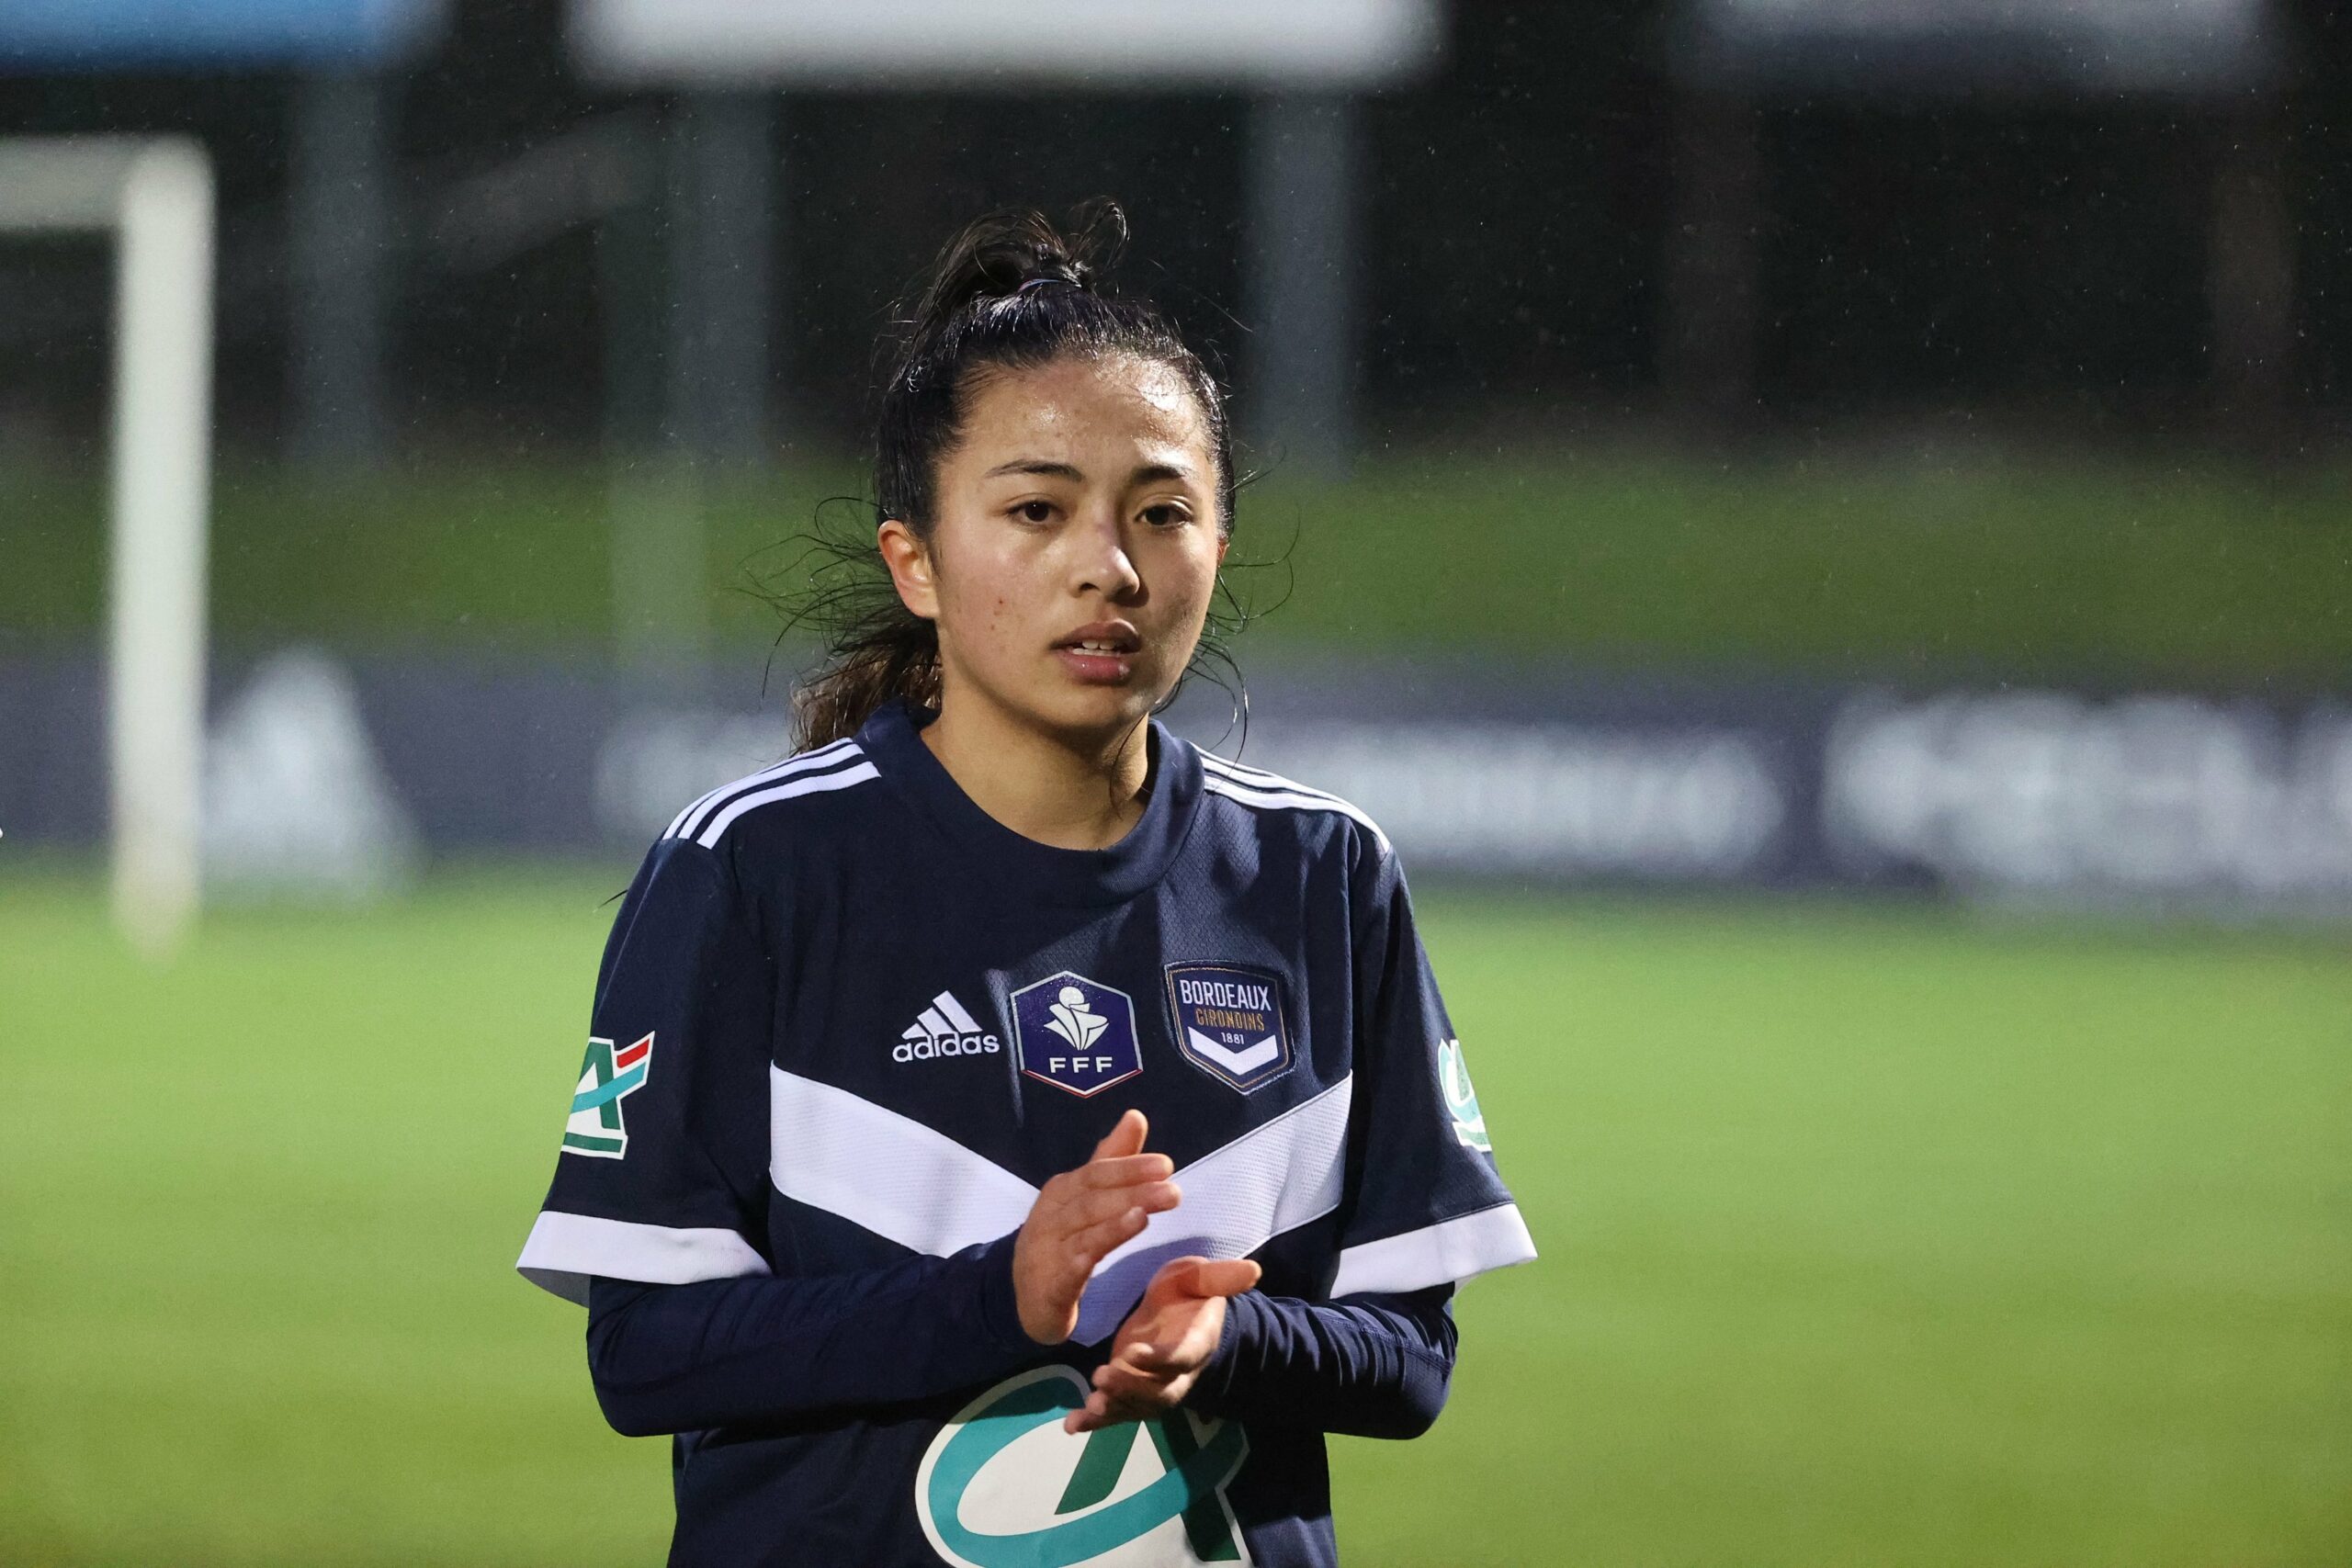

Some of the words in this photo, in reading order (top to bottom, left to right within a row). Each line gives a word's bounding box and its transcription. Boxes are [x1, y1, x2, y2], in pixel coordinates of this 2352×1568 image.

[1180, 979, 1272, 1011] BORDEAUX
[1195, 1008, 1265, 1032] GIRONDINS
[892, 1031, 1000, 1063] adidas
[1221, 1032, 1244, 1044] 1881
